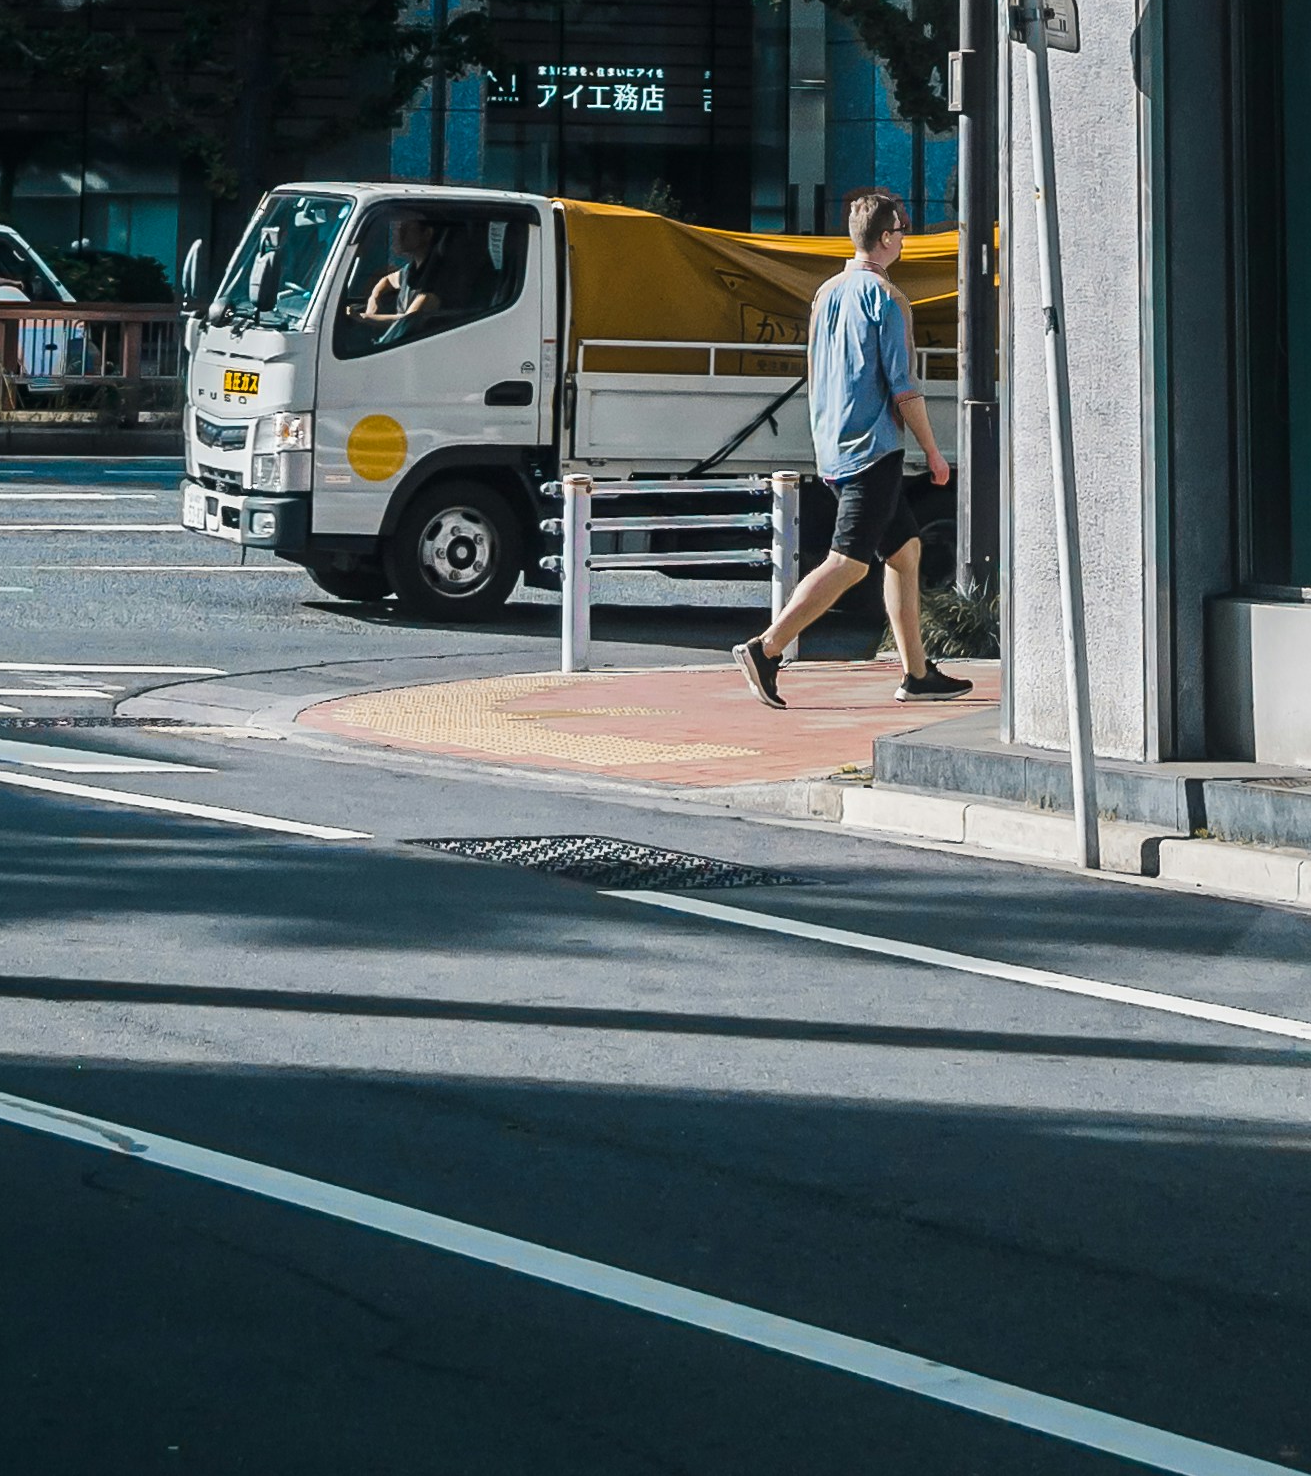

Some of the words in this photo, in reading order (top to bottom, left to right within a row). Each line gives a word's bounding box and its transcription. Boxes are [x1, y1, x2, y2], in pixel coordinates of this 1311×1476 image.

[537, 83, 665, 112] アイ工務店
[224, 371, 260, 394] 高圧ガス
[198, 388, 247, 405] FUSO
